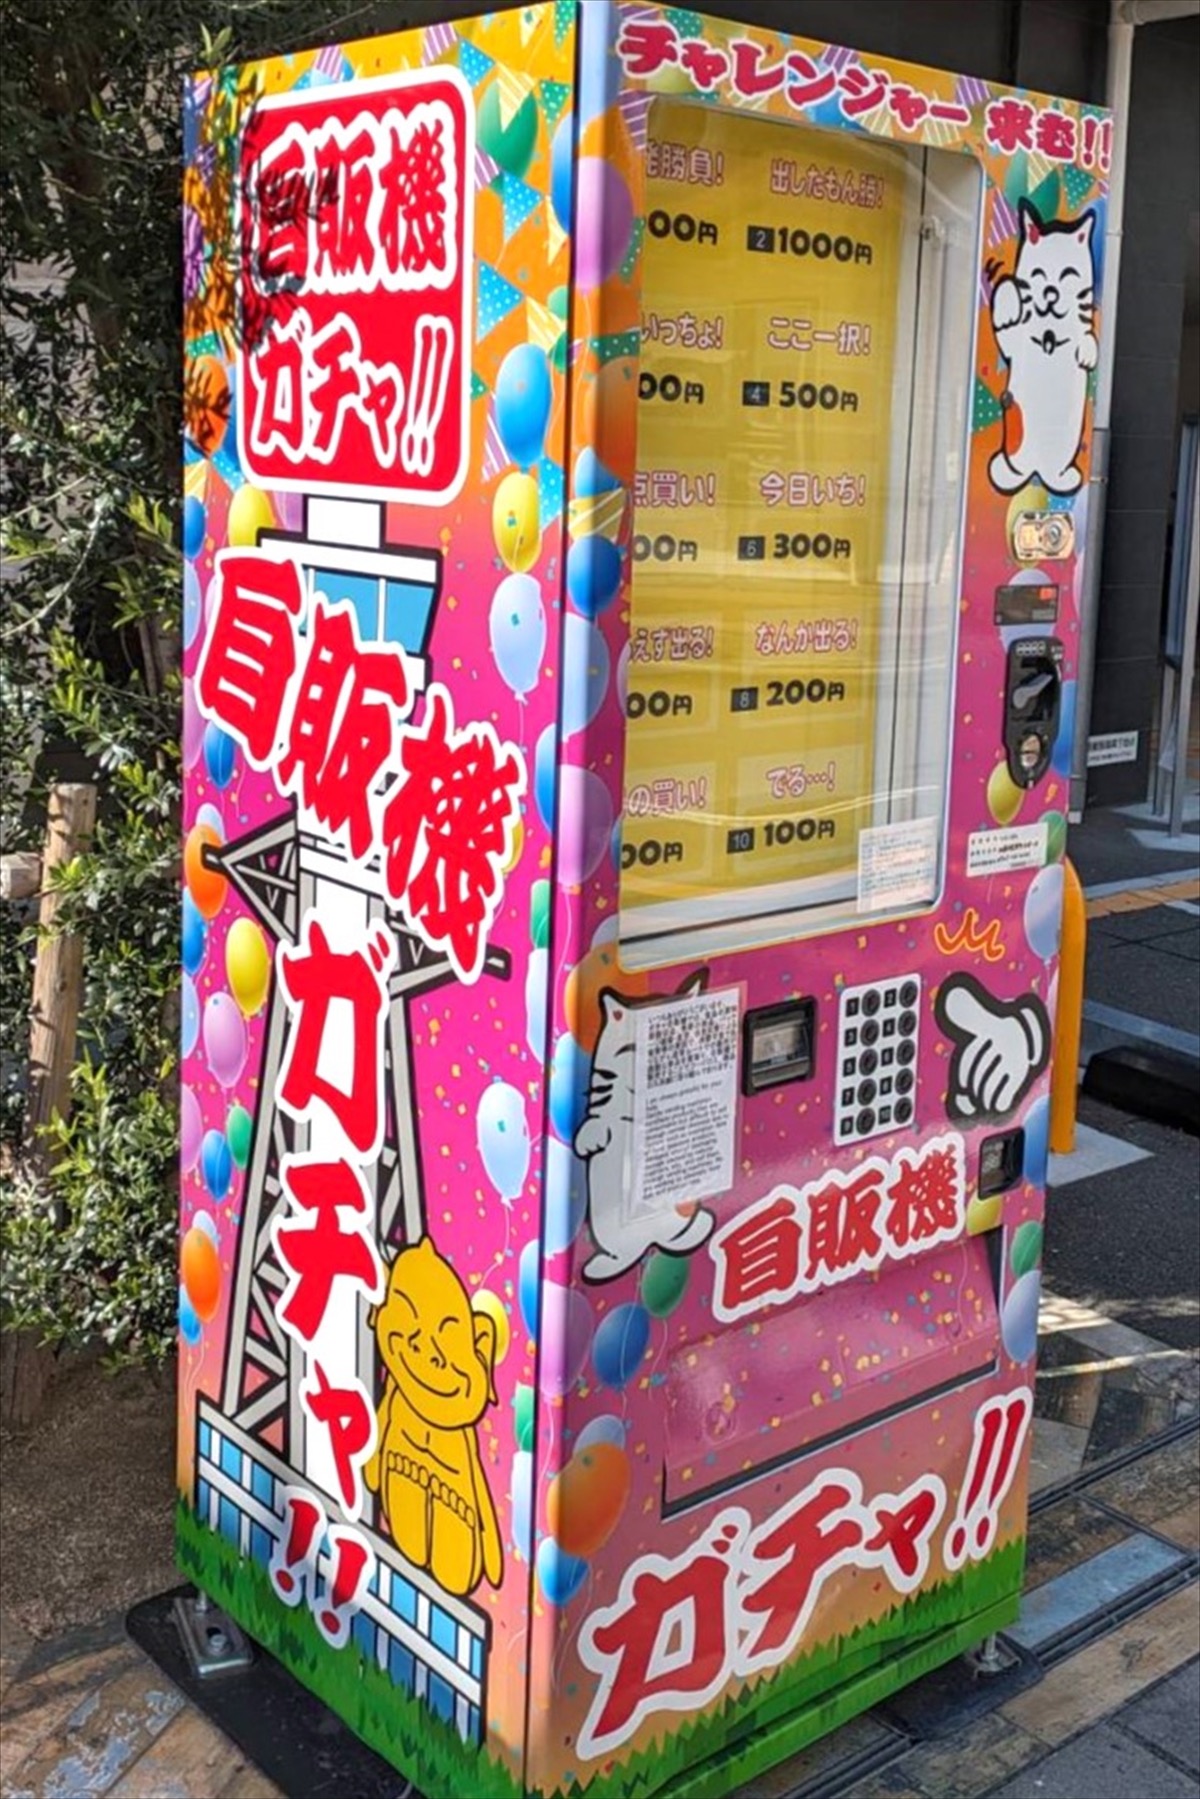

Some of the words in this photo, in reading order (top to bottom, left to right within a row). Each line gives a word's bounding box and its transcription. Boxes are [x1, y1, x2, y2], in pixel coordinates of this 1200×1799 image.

[618, 20, 970, 129] チャレンジャー
[778, 227, 872, 265] 1000円
[767, 317, 870, 355] ここ一択!
[779, 381, 858, 412] 500円
[760, 470, 866, 507] 今日いち!
[773, 532, 851, 559] 300円
[630, 626, 714, 662] えず出る!
[755, 618, 858, 655] なんか出る!
[766, 678, 845, 706] 200円
[197, 552, 523, 976] 自販機
[624, 776, 707, 818] の買い!
[764, 818, 836, 847] 100円
[717, 1141, 959, 1311] 自販機
[588, 1396, 1028, 1743] ガチャ!!
